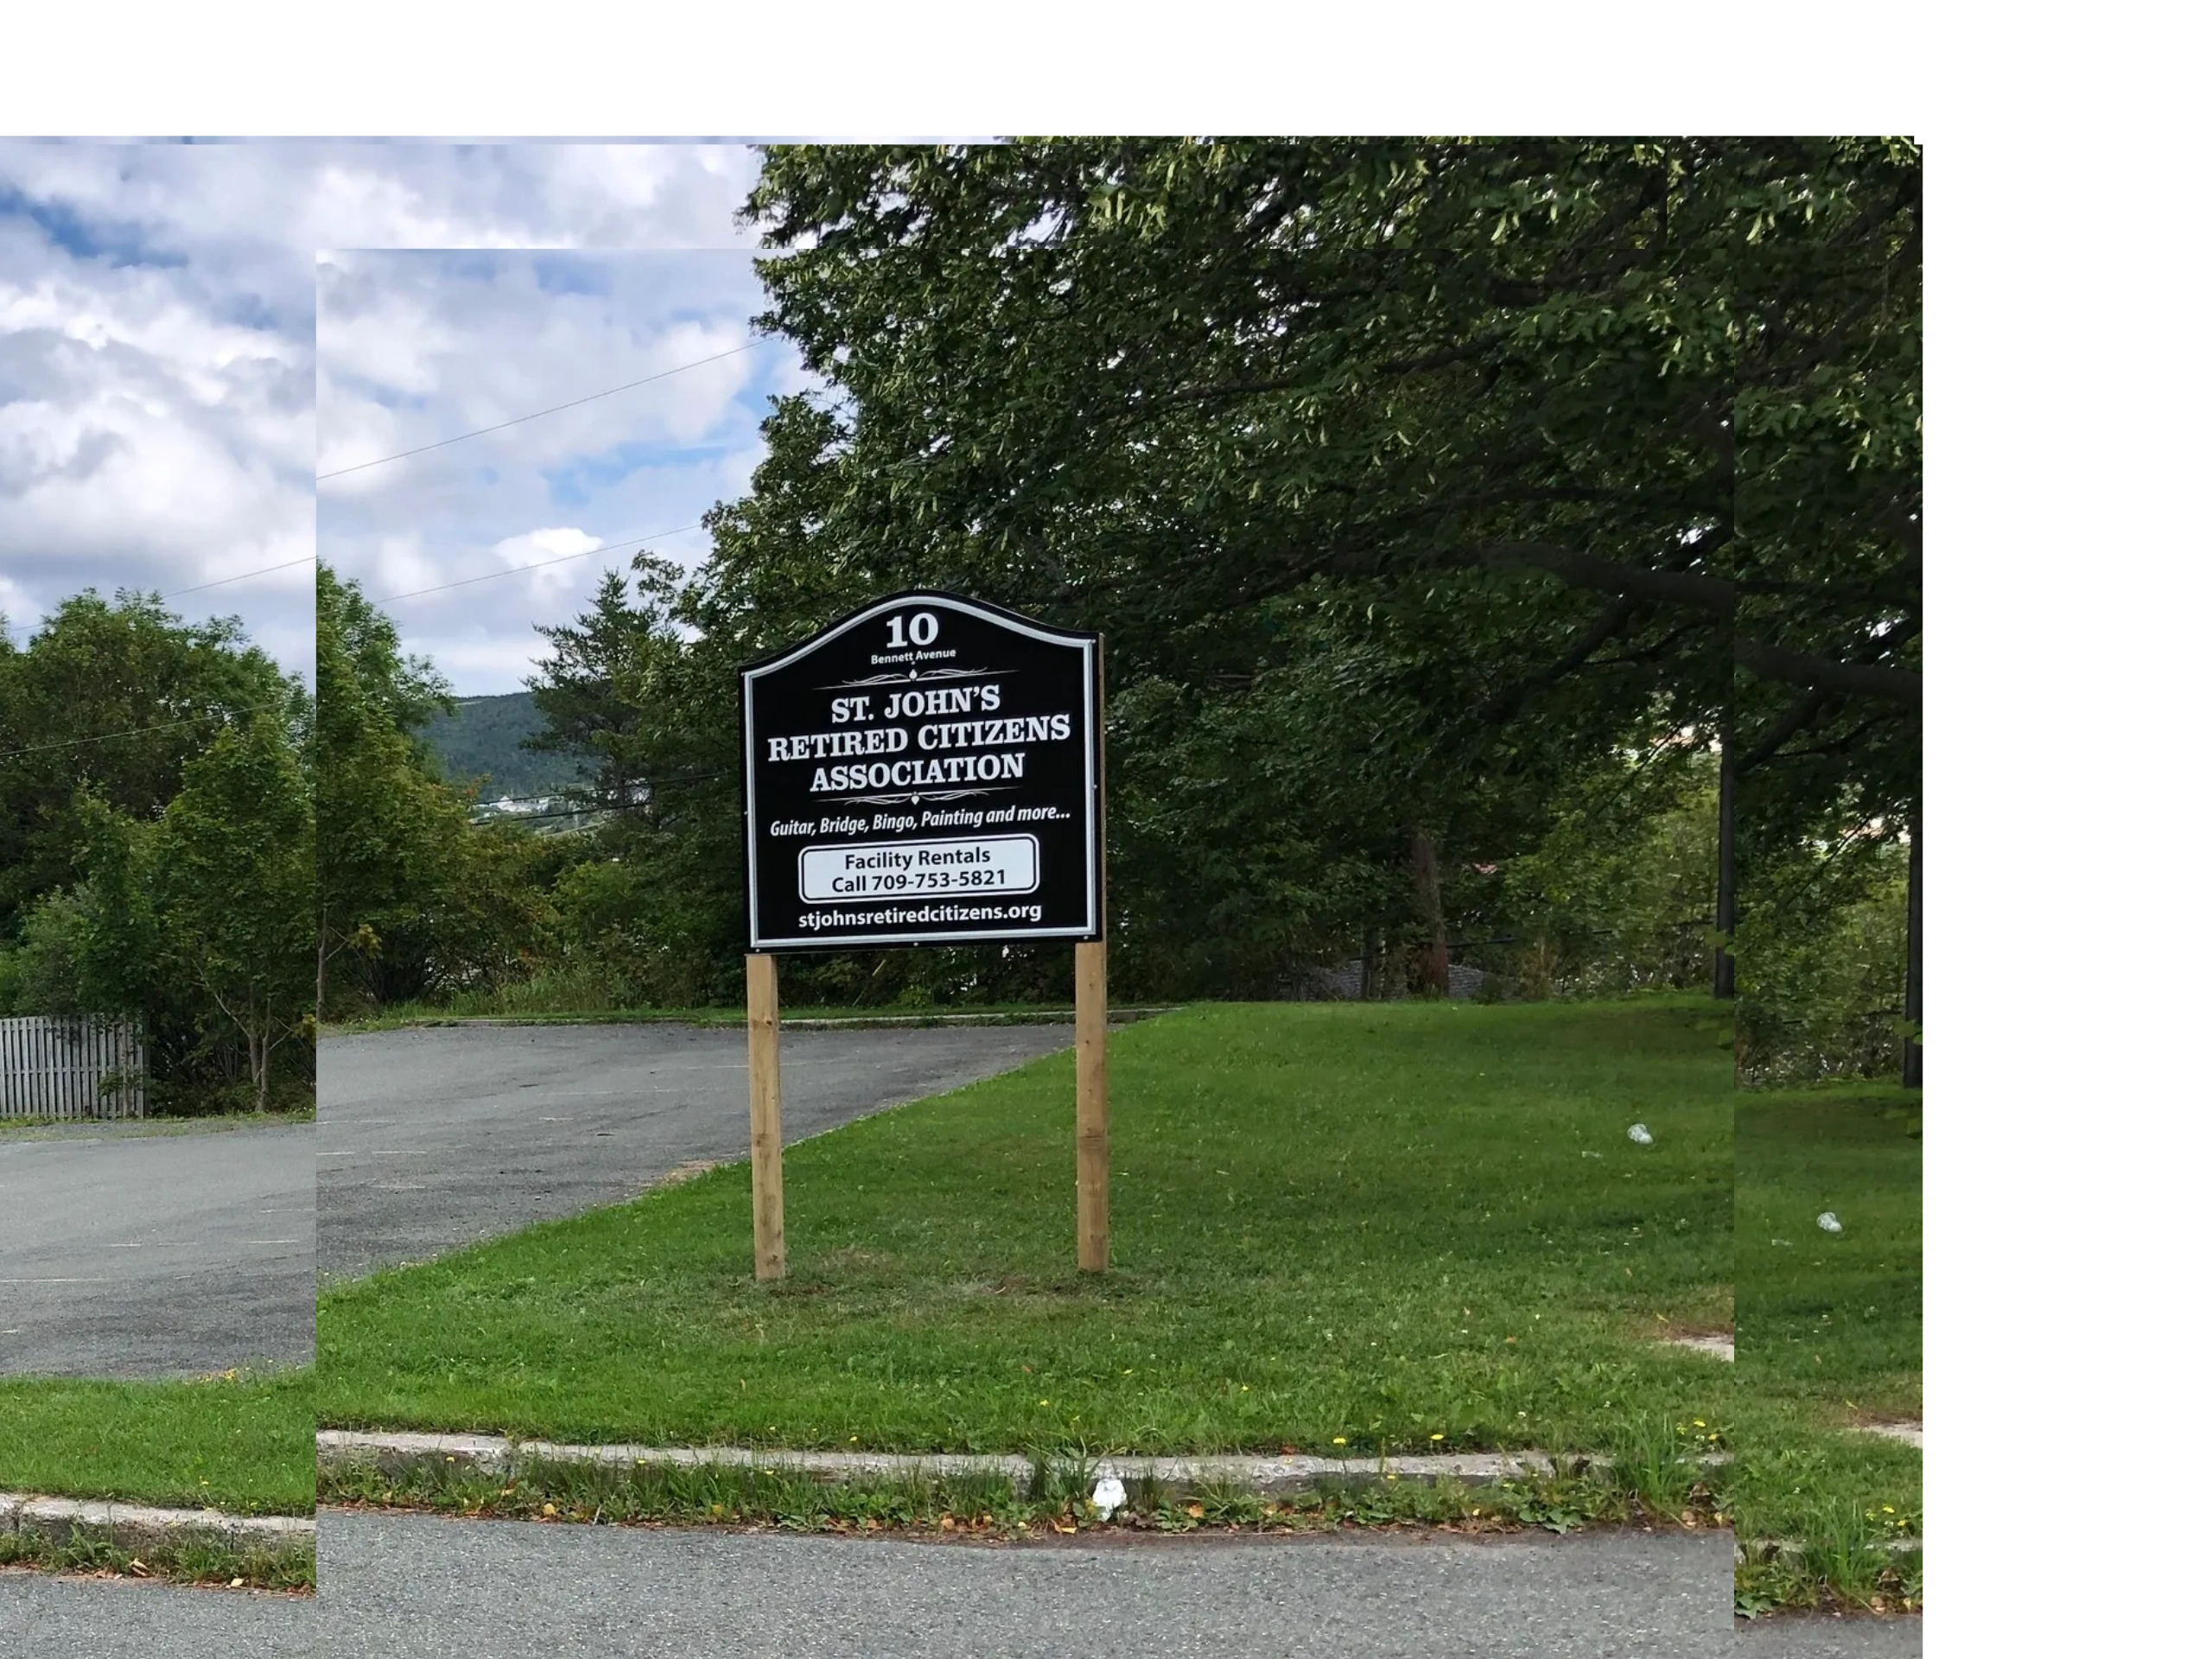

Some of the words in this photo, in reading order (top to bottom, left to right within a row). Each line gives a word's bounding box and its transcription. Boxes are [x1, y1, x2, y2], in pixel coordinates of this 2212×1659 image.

[886, 613, 938, 648] 10
[871, 651, 914, 664] Bennett
[915, 647, 957, 661] Avenue
[831, 696, 874, 723] ST.
[884, 684, 1001, 718] JOHN'S
[768, 728, 908, 761] RETIRED
[918, 714, 1071, 751] CITIZENS
[810, 753, 1025, 791] ASSOCIATION
[771, 820, 817, 836] Guitar,
[820, 817, 869, 834] Bridge,
[873, 814, 917, 830] Bingo,
[921, 810, 982, 829] Painting
[986, 808, 1014, 823] and
[1017, 806, 1071, 821] more...
[845, 851, 912, 870] Facility
[918, 847, 990, 866] Rentals
[832, 874, 867, 892] Call
[872, 869, 1005, 891] 709-753-5821
[798, 903, 1041, 931] stjohnsretiredcitizens.org
